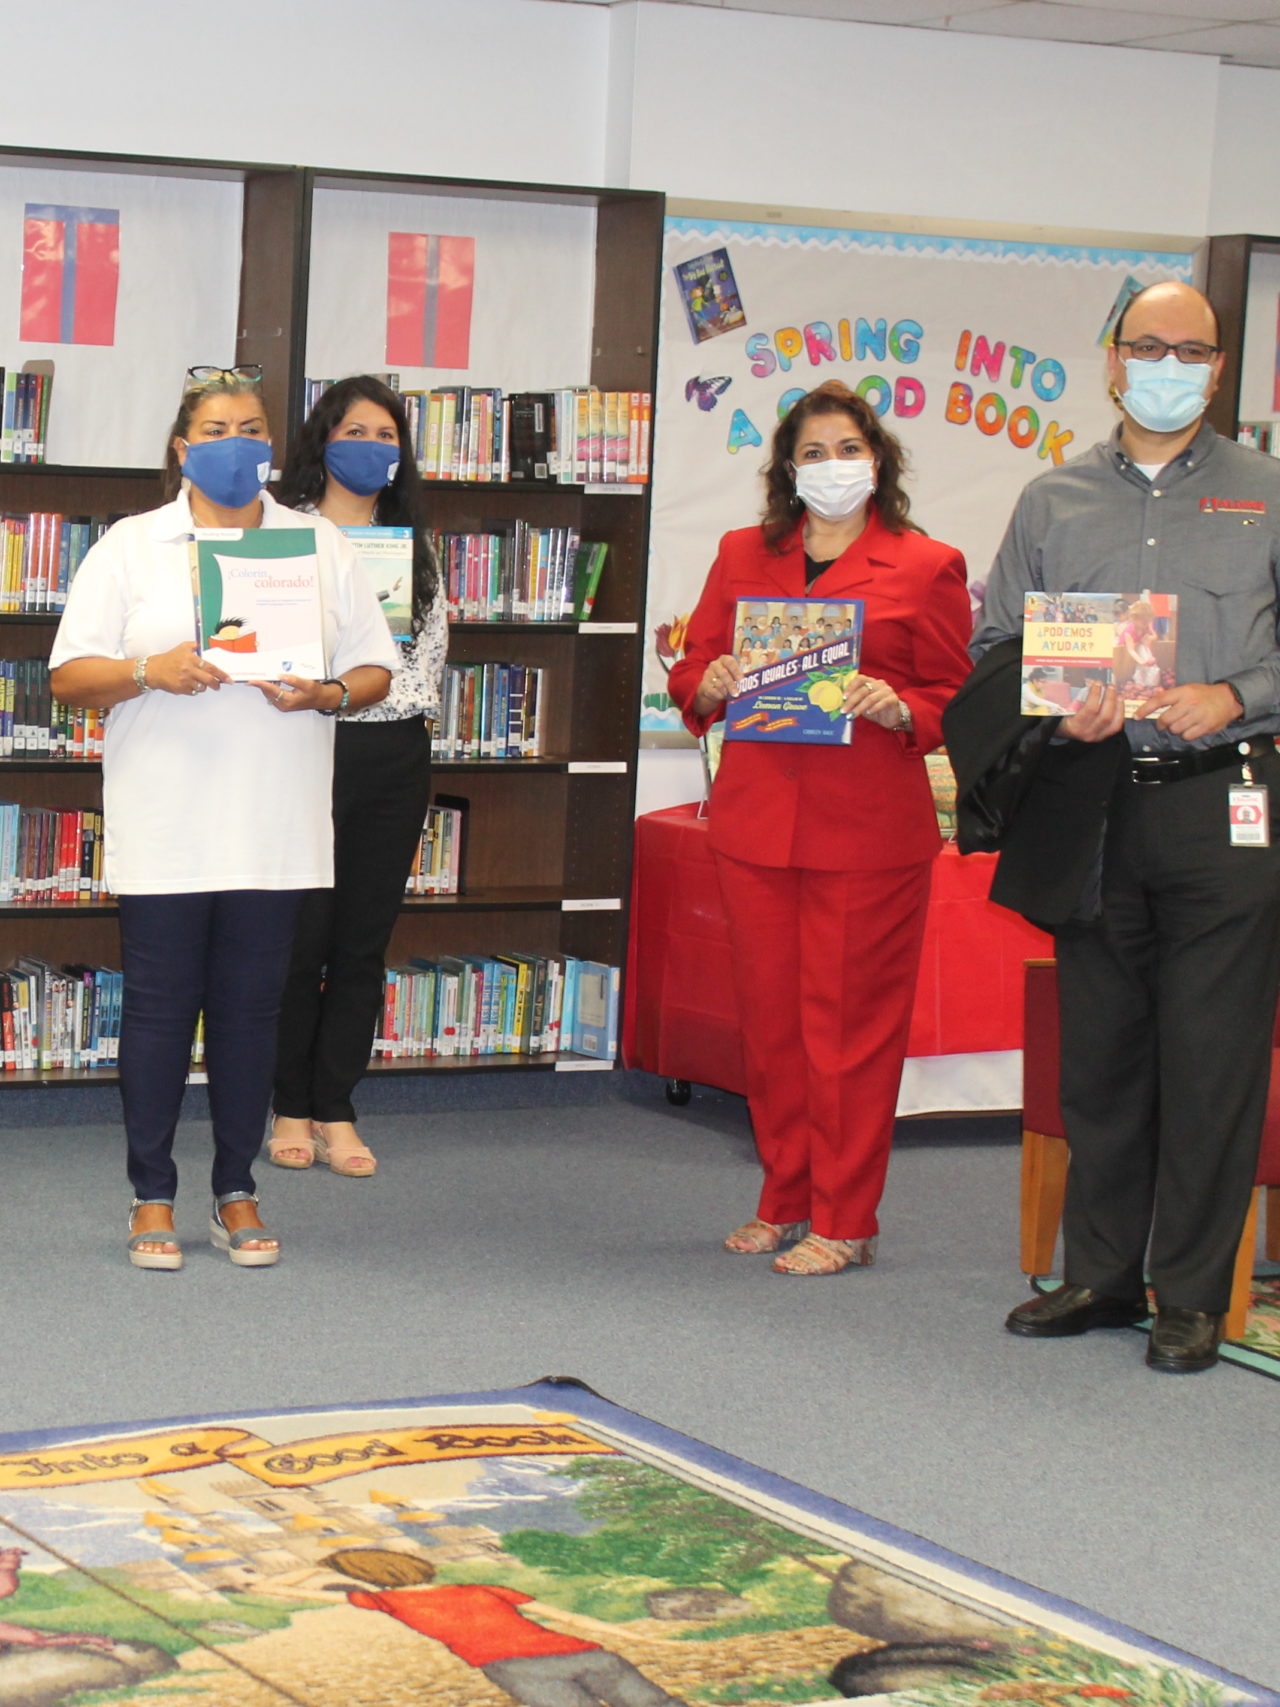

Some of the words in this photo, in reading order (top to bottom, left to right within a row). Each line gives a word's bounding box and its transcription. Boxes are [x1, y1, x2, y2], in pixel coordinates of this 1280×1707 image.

[25, 203, 120, 344] T
[745, 317, 925, 378] SPRING
[955, 329, 1066, 402] INTO
[727, 409, 762, 454] A
[945, 381, 1074, 466] BOOK
[254, 576, 314, 588] colorado!
[761, 661, 798, 686] IGUALES
[802, 652, 819, 672] ALL
[822, 642, 850, 664] EQUAL
[1042, 641, 1094, 652] AYUDAR?
[0, 1453, 149, 1478] Into
[265, 1440, 407, 1475] Good
